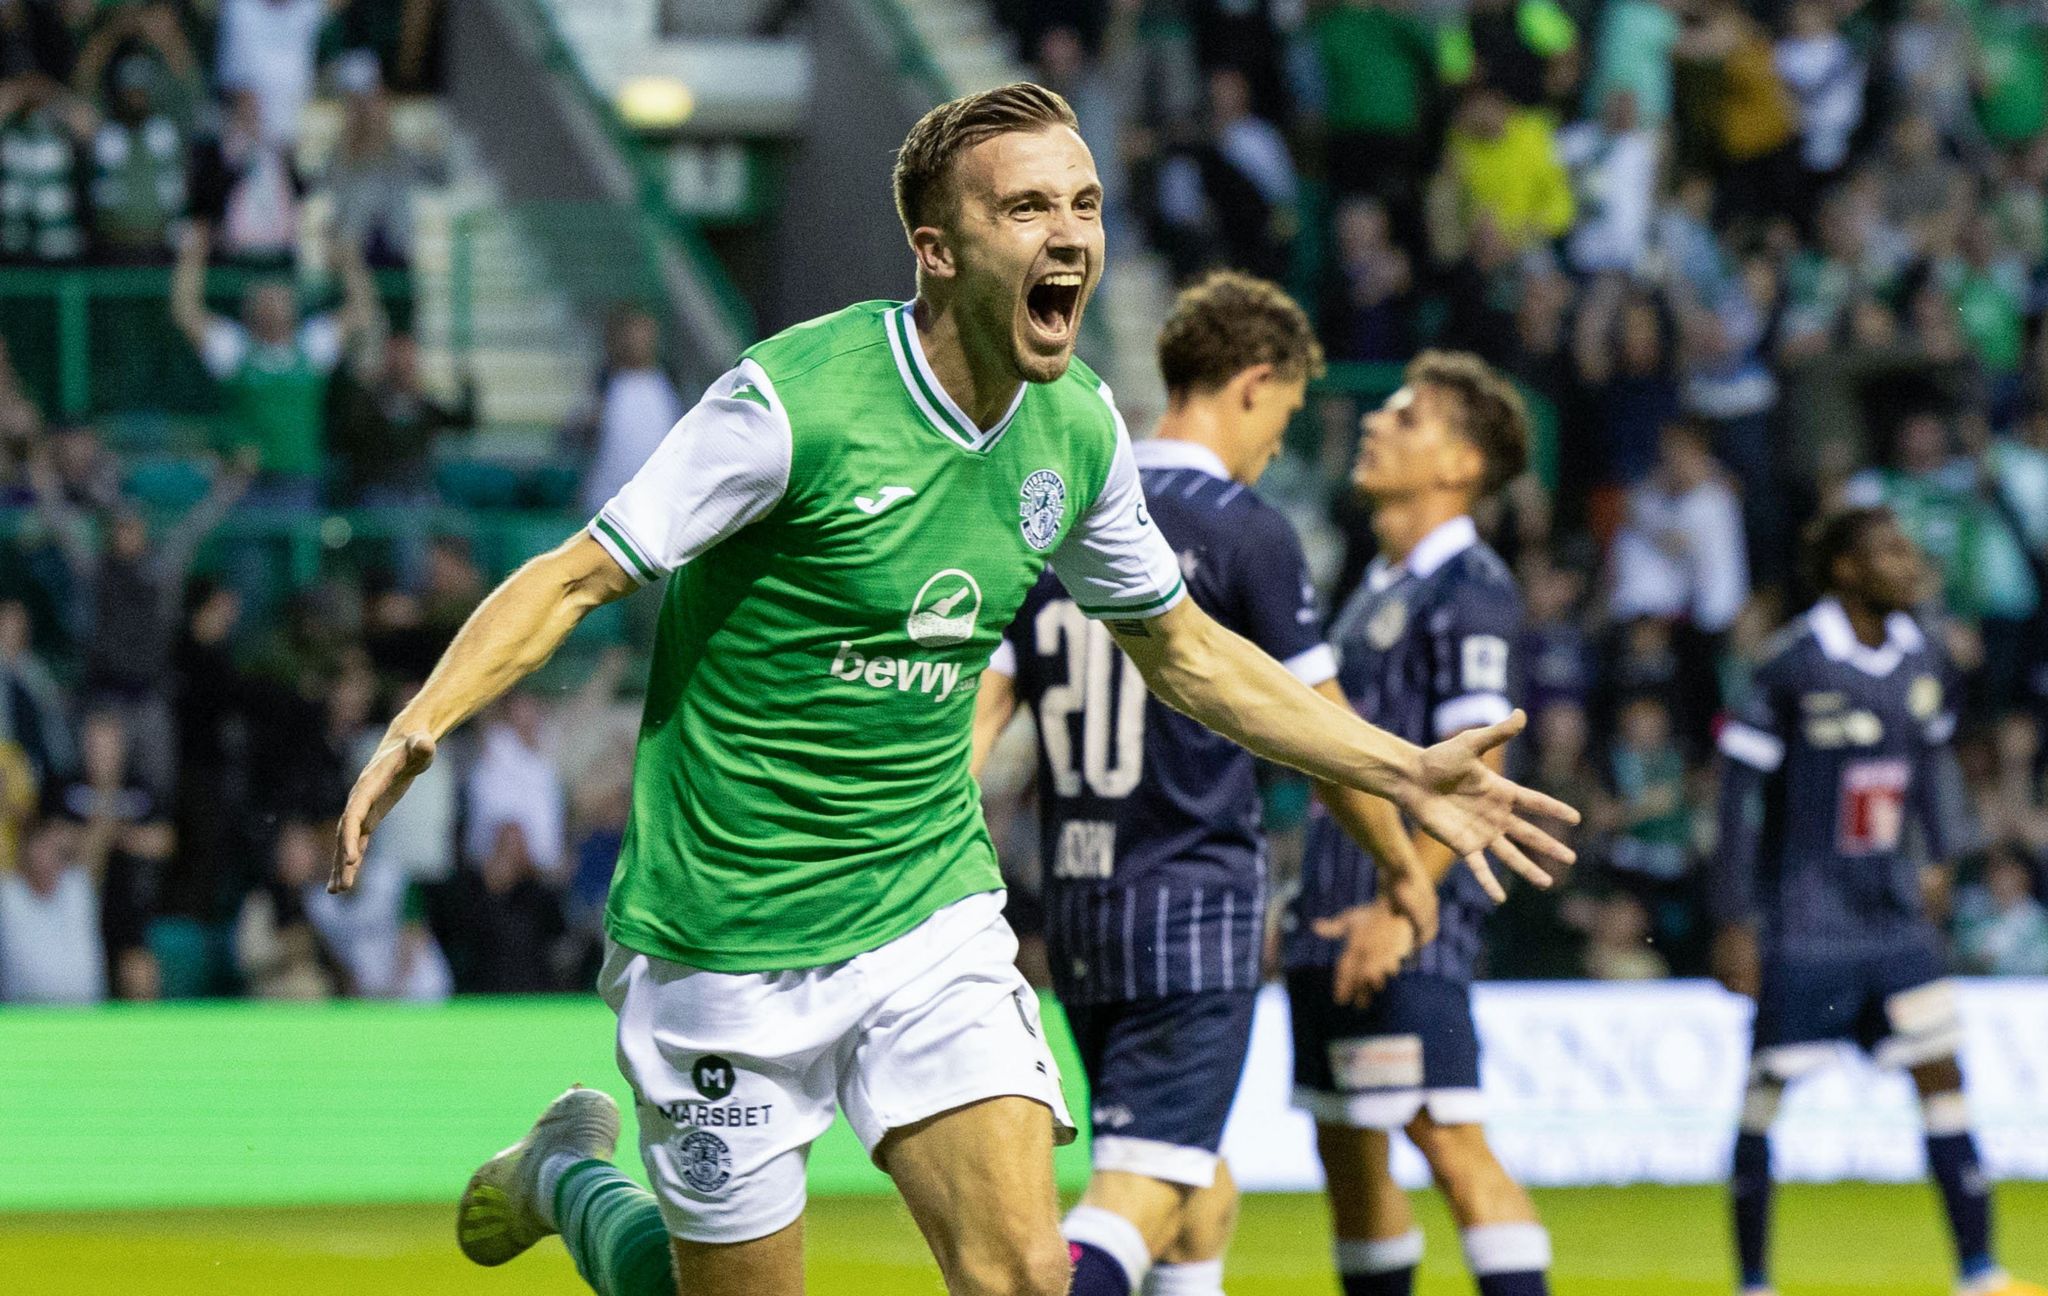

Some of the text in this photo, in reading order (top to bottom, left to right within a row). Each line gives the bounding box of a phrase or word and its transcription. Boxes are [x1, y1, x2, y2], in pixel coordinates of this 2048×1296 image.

[831, 641, 962, 702] bevvy
[1034, 600, 1147, 798] 20
[701, 1067, 726, 1089] M
[658, 1104, 772, 1127] MARSBET
